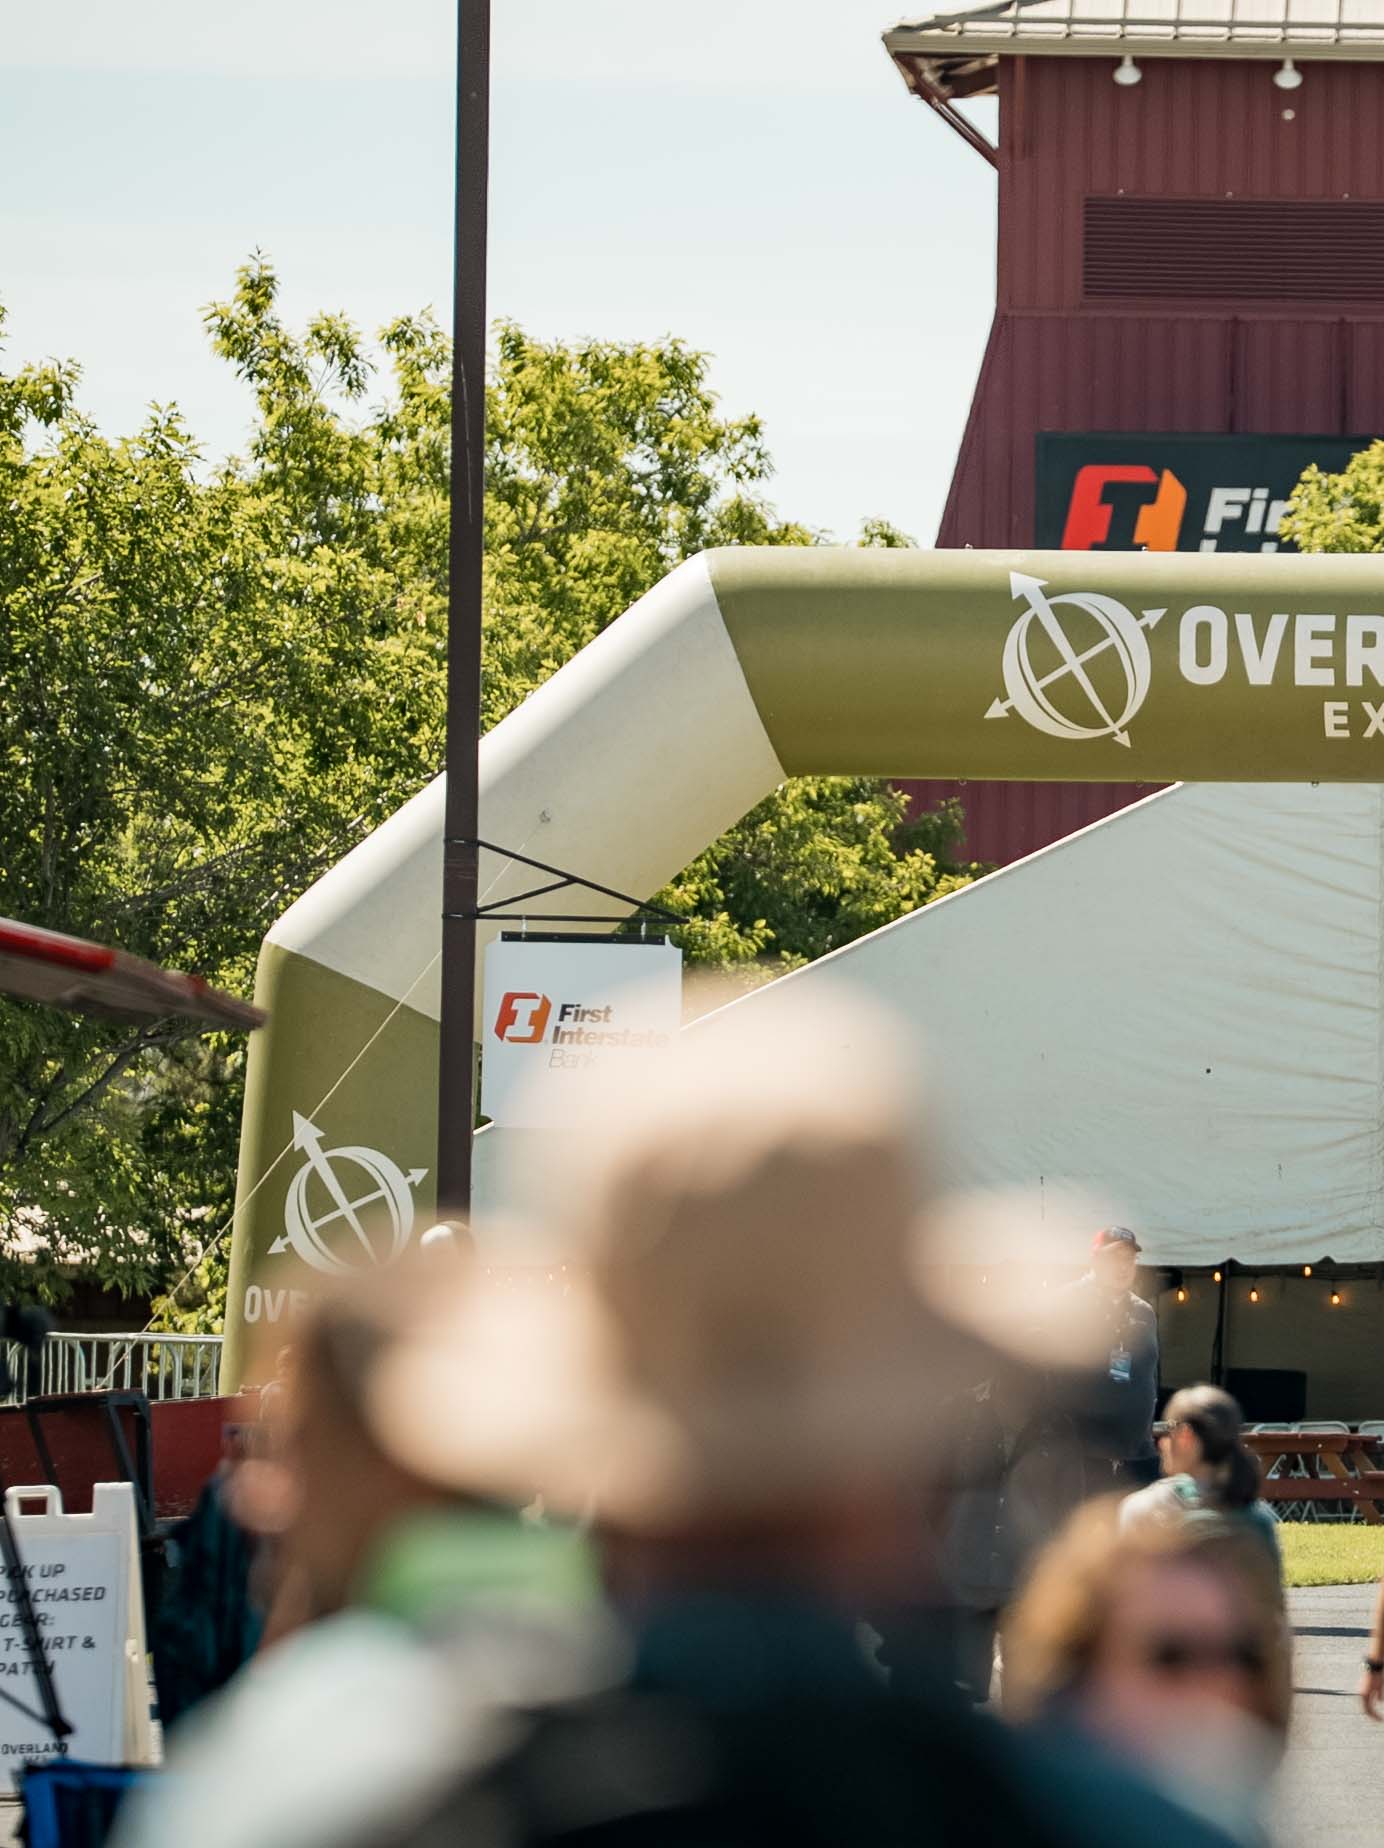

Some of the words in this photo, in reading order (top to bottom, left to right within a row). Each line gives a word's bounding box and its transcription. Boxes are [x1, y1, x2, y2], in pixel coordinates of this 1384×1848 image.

[1203, 487, 1294, 534] Fir
[558, 1003, 613, 1023] First
[549, 1048, 600, 1069] Ban
[40, 1563, 66, 1579] UP
[0, 1586, 107, 1604] PUCHASED
[0, 1612, 55, 1628] GER:
[81, 1635, 97, 1650] &
[0, 1660, 56, 1676] PATH
